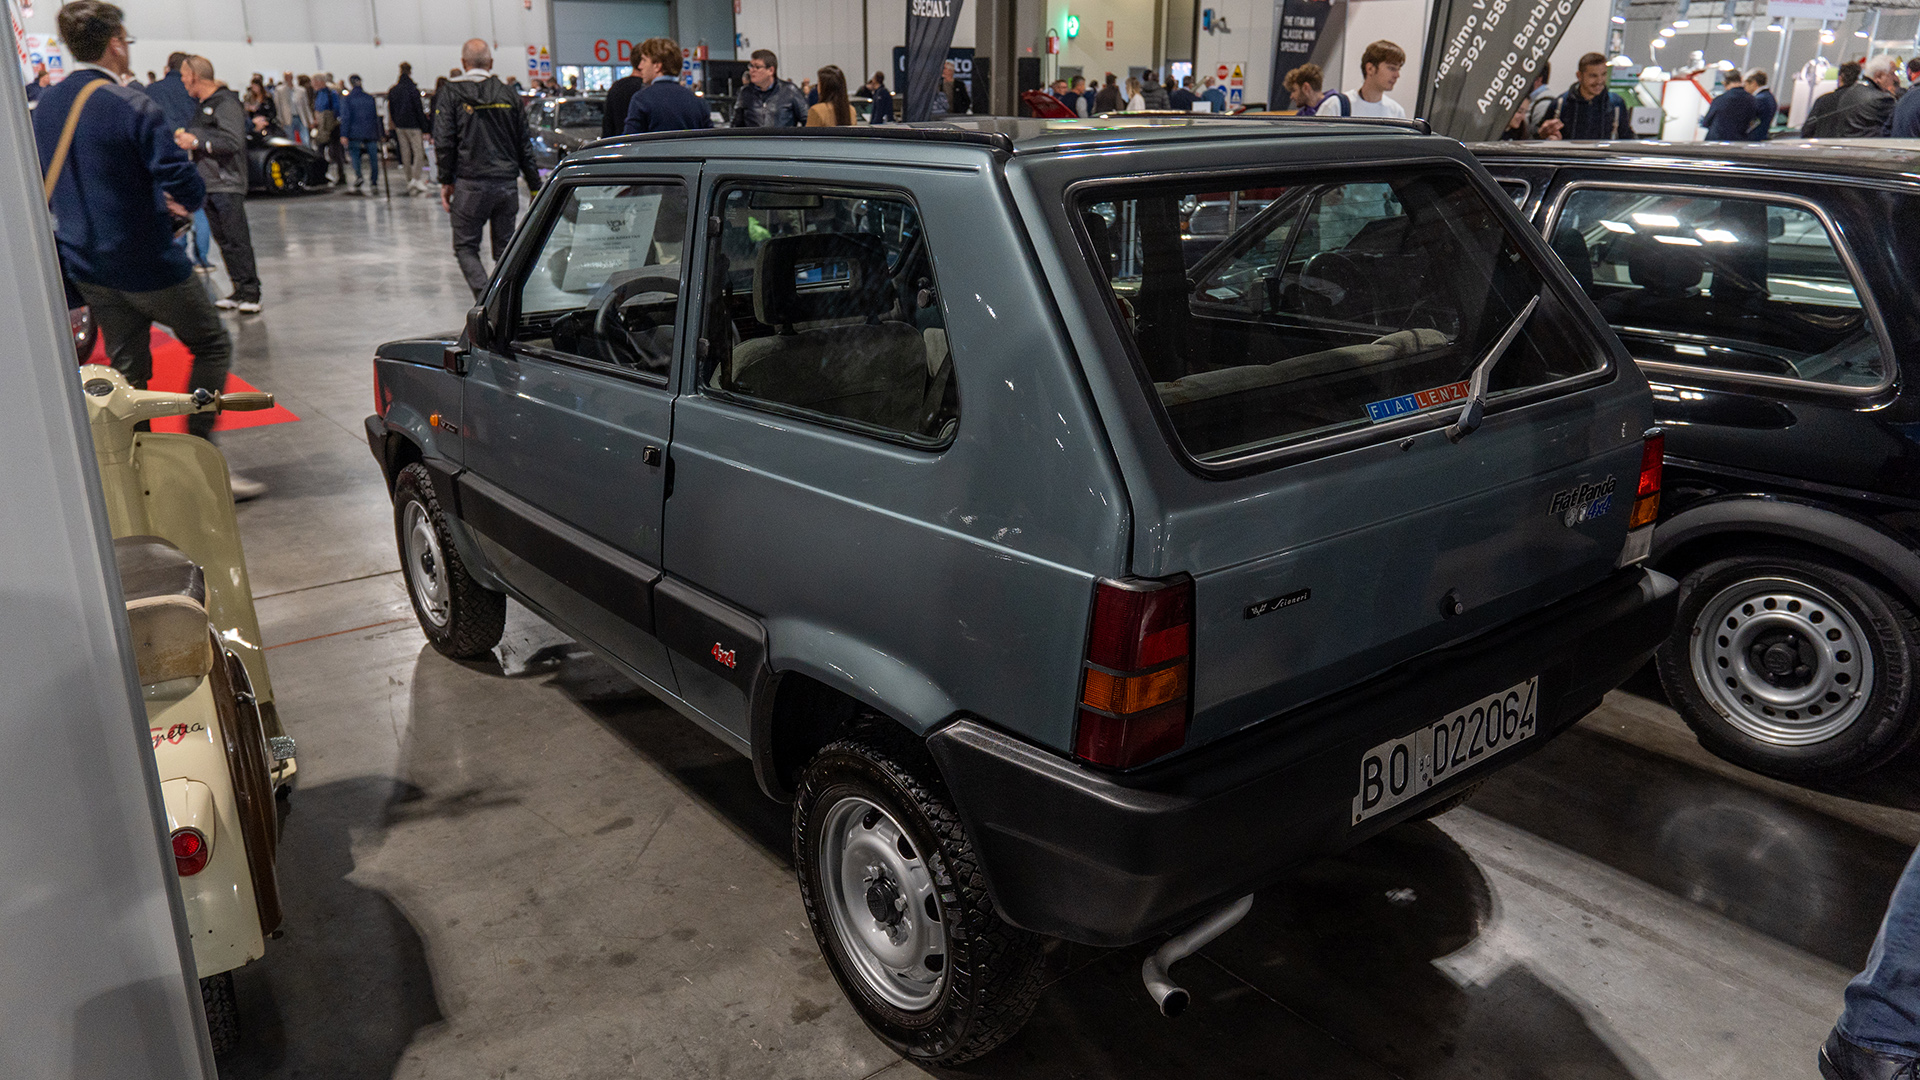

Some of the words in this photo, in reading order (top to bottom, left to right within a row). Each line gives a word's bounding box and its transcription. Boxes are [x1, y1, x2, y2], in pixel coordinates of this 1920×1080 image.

[594, 39, 611, 62] 6
[1460, 35, 1487, 73] 392
[1481, 0, 1511, 32] 158
[1477, 52, 1518, 115] Angelo
[1512, 0, 1552, 50] Barbi
[1499, 74, 1527, 111] 338
[1522, 0, 1576, 73] 643076
[1370, 397, 1415, 418] FIAT
[1549, 487, 1578, 516] Fiat
[1576, 474, 1617, 505] Panda
[1586, 492, 1612, 520] 4x4
[711, 642, 737, 669] 4x4
[1362, 743, 1409, 812] BO
[1433, 681, 1536, 778] D22064
